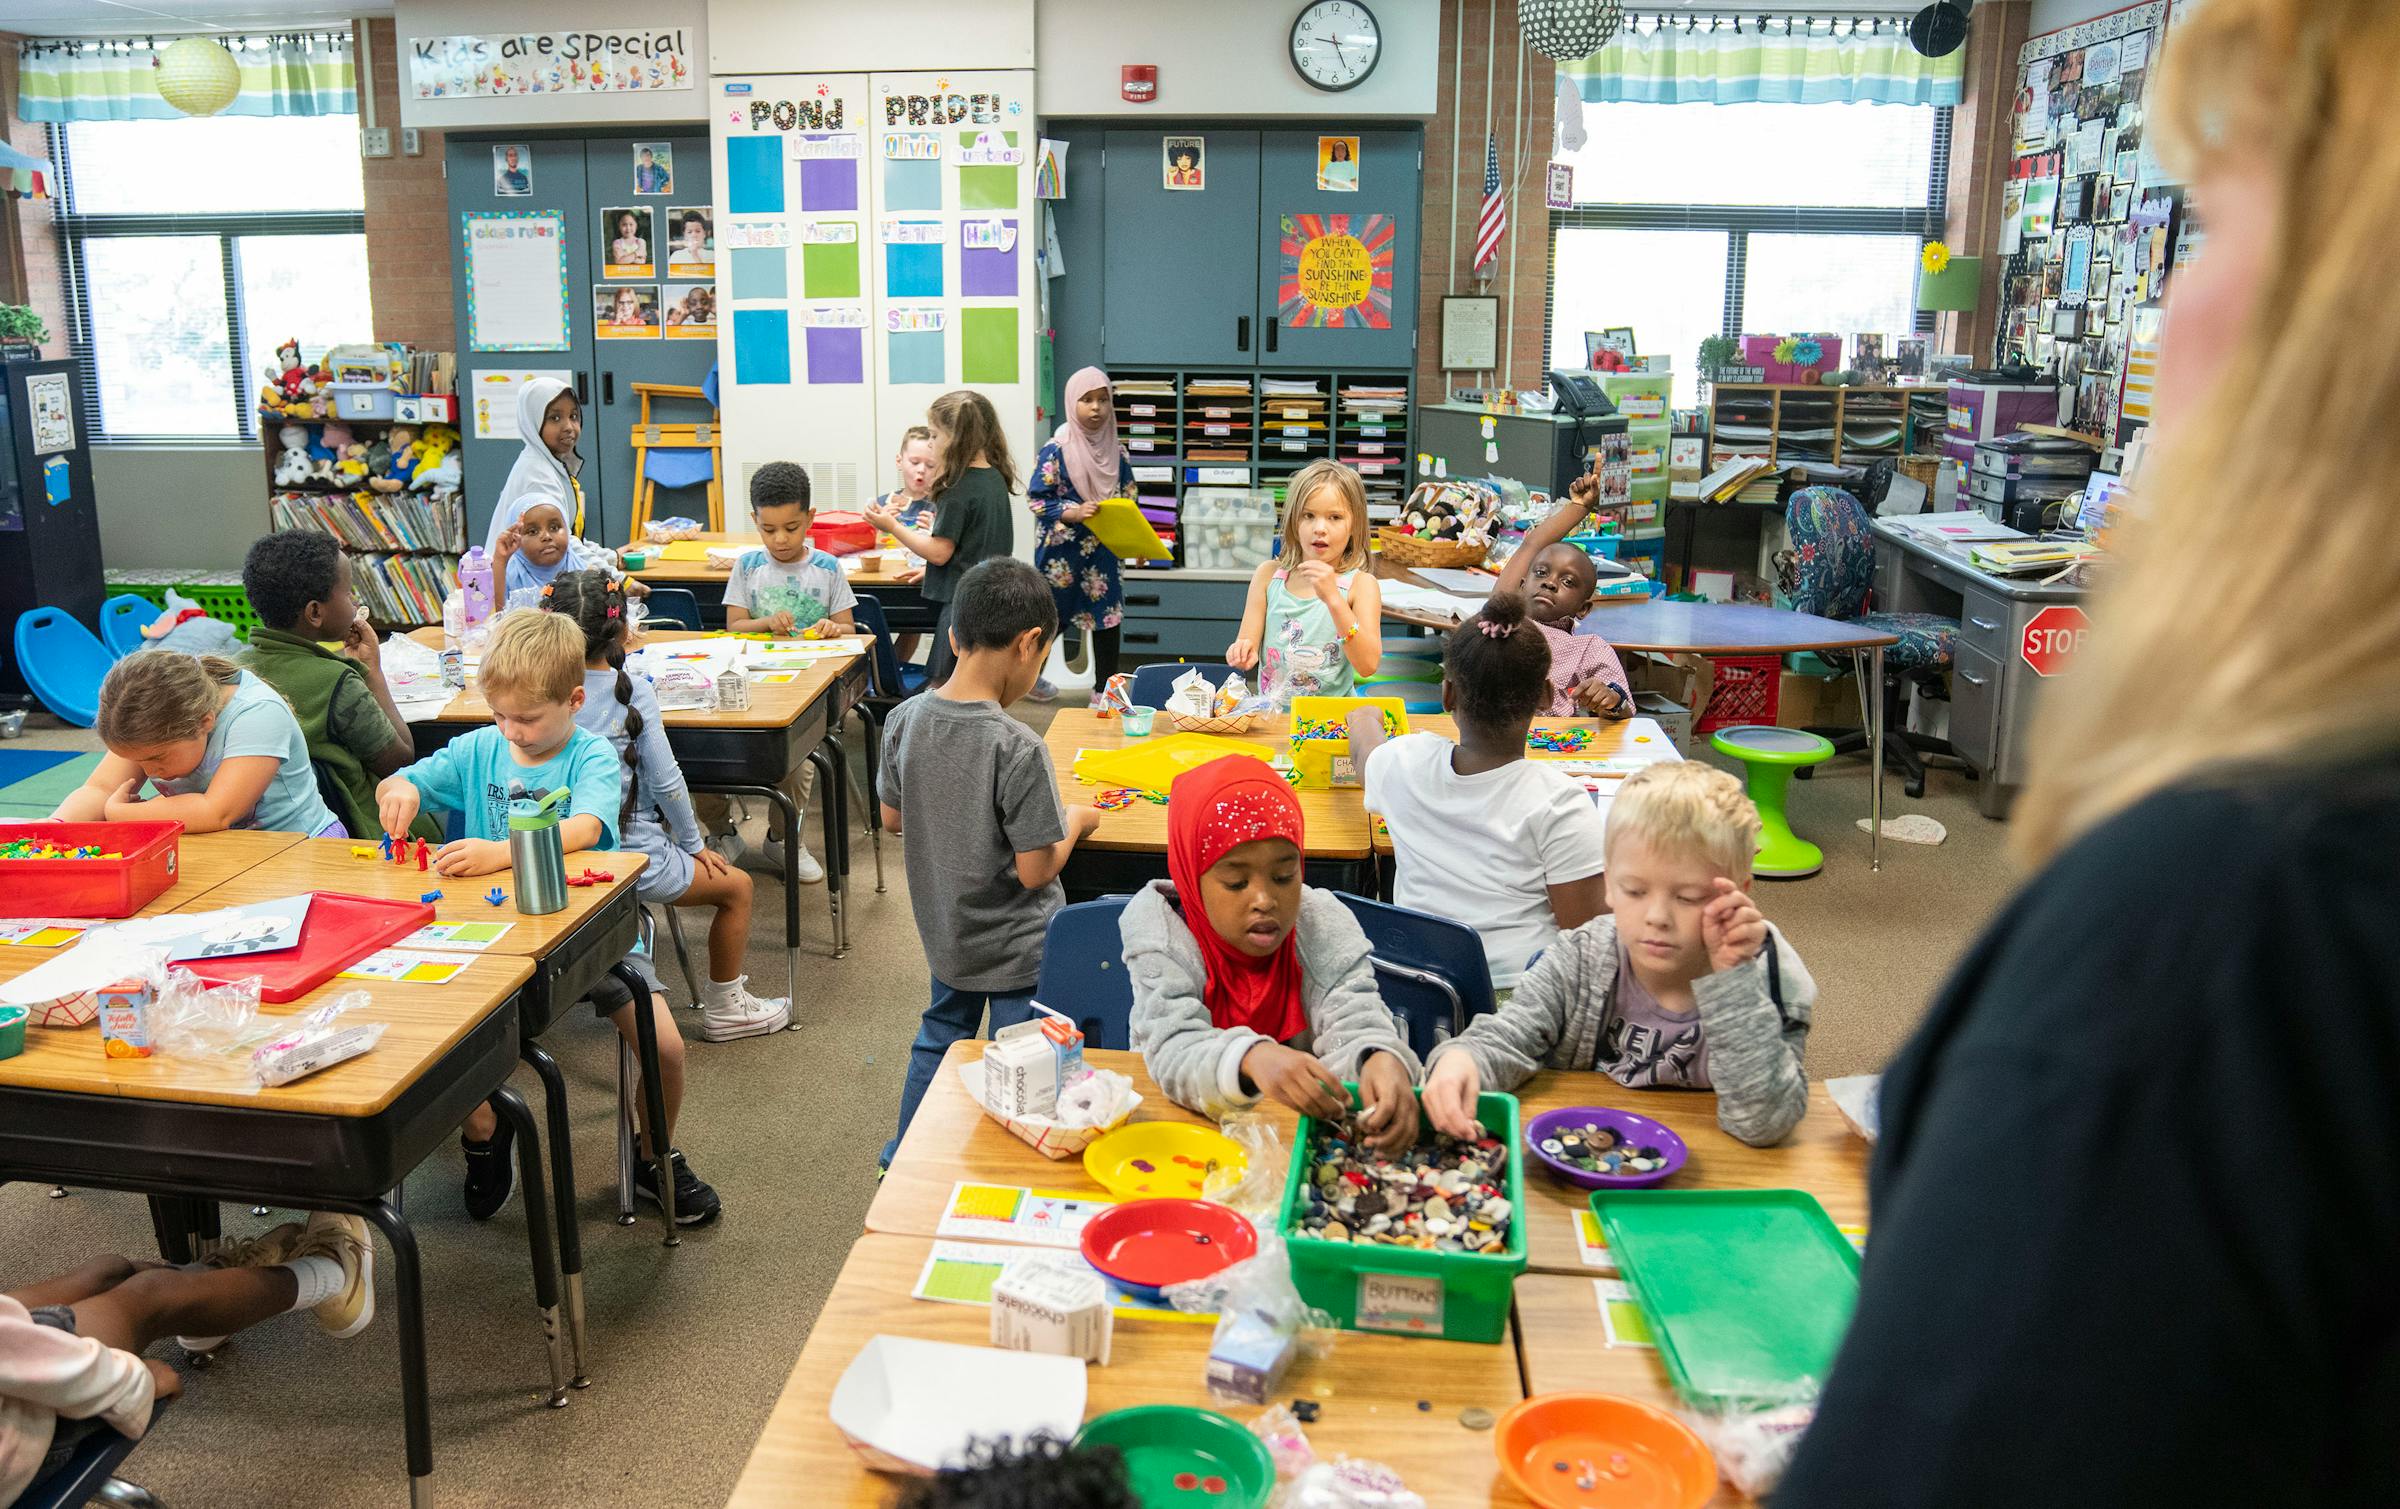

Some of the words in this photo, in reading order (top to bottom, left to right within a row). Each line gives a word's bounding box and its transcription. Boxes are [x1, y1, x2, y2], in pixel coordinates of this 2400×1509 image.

[1331, 2, 1341, 12] 12
[1314, 8, 1321, 17] 11
[1301, 22, 1311, 31] 10
[1363, 19, 1369, 29] 2
[1297, 38, 1305, 48] 9
[416, 39, 490, 68] Kids
[501, 33, 554, 59] are
[561, 29, 685, 62] special
[1302, 57, 1309, 67] 8
[1360, 55, 1367, 64] 4
[1315, 70, 1321, 79] 7
[1331, 73, 1339, 83] 6
[1349, 69, 1355, 78] 5
[885, 93, 1001, 126] PRIDE!
[885, 136, 940, 160] Olivia
[1168, 140, 1202, 148] FUTURE
[1321, 238, 1351, 248] WHEN
[1310, 248, 1330, 259] YOU
[1333, 248, 1361, 259] CAN'T
[1316, 260, 1336, 268] FIND
[1339, 260, 1353, 268] THE
[1305, 269, 1365, 281] SUNSHINE
[1320, 281, 1331, 291] BE
[1335, 282, 1350, 291] THE
[1307, 287, 1362, 304] SUNSHINE
[107, 1013, 137, 1023] Totally
[1015, 1065, 1027, 1117] chocolat
[1368, 1281, 1438, 1304] BUTTONS
[997, 1290, 1067, 1326] chocolate
